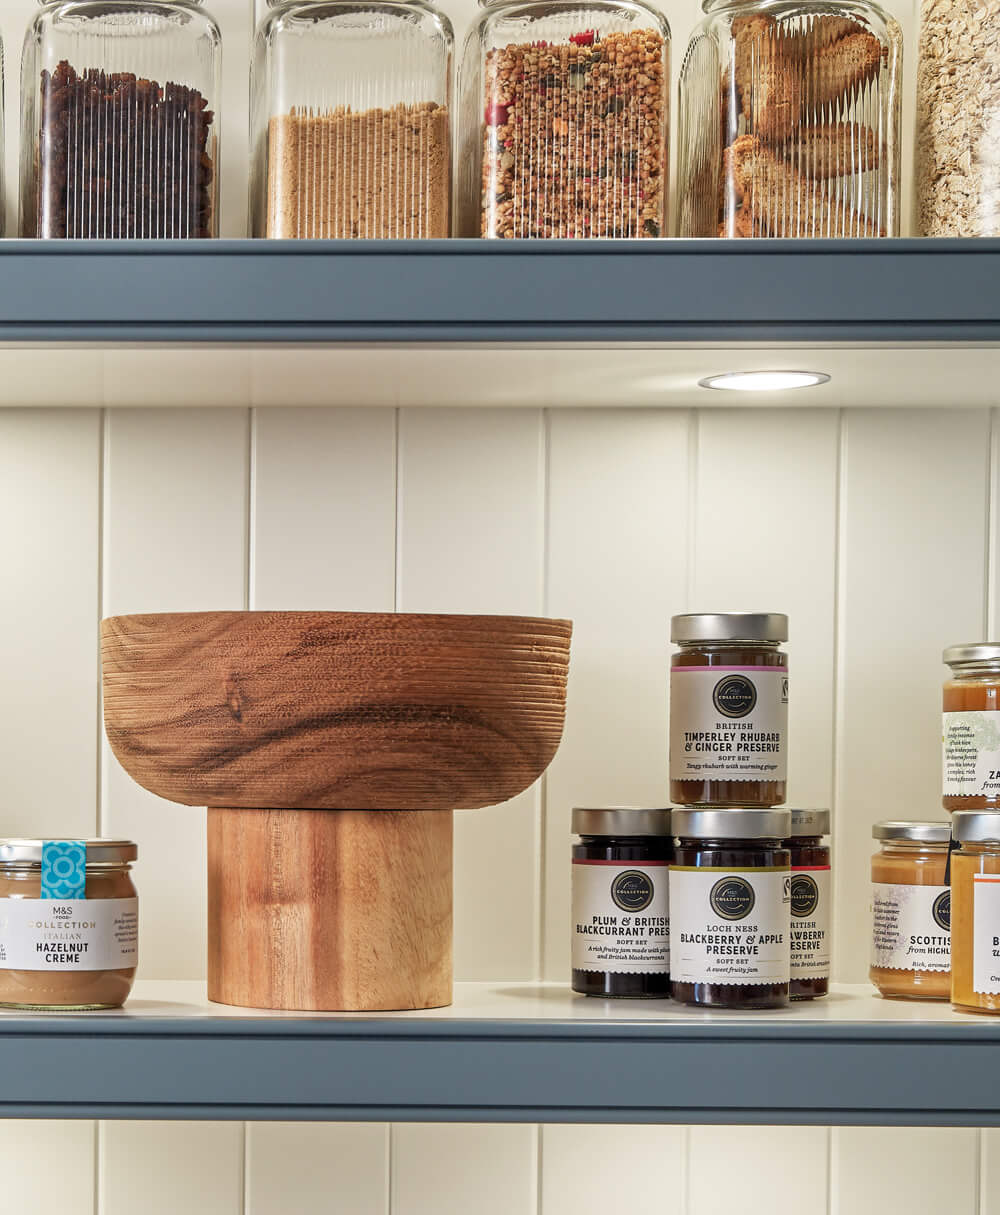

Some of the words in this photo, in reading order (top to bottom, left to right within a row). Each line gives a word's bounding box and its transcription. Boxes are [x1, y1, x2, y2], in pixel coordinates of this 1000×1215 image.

[684, 732, 736, 742] TIMPERLEY
[740, 732, 780, 742] RHUBARB
[684, 743, 692, 752] &
[695, 743, 732, 752] GINGER
[737, 743, 780, 752] PRESERVE
[53, 907, 73, 915] M&S
[592, 916, 617, 926] PLUM
[621, 917, 631, 926] &
[634, 917, 670, 926] BRITISH
[576, 924, 645, 936] BLACKCURRANT
[680, 934, 741, 944] BLACKBERRY
[746, 935, 756, 944] &
[758, 934, 783, 944] APPLE
[36, 943, 89, 952] HAZELNUT
[706, 946, 759, 955] PRESERVE
[906, 946, 926, 955] from
[45, 954, 80, 963] CREME
